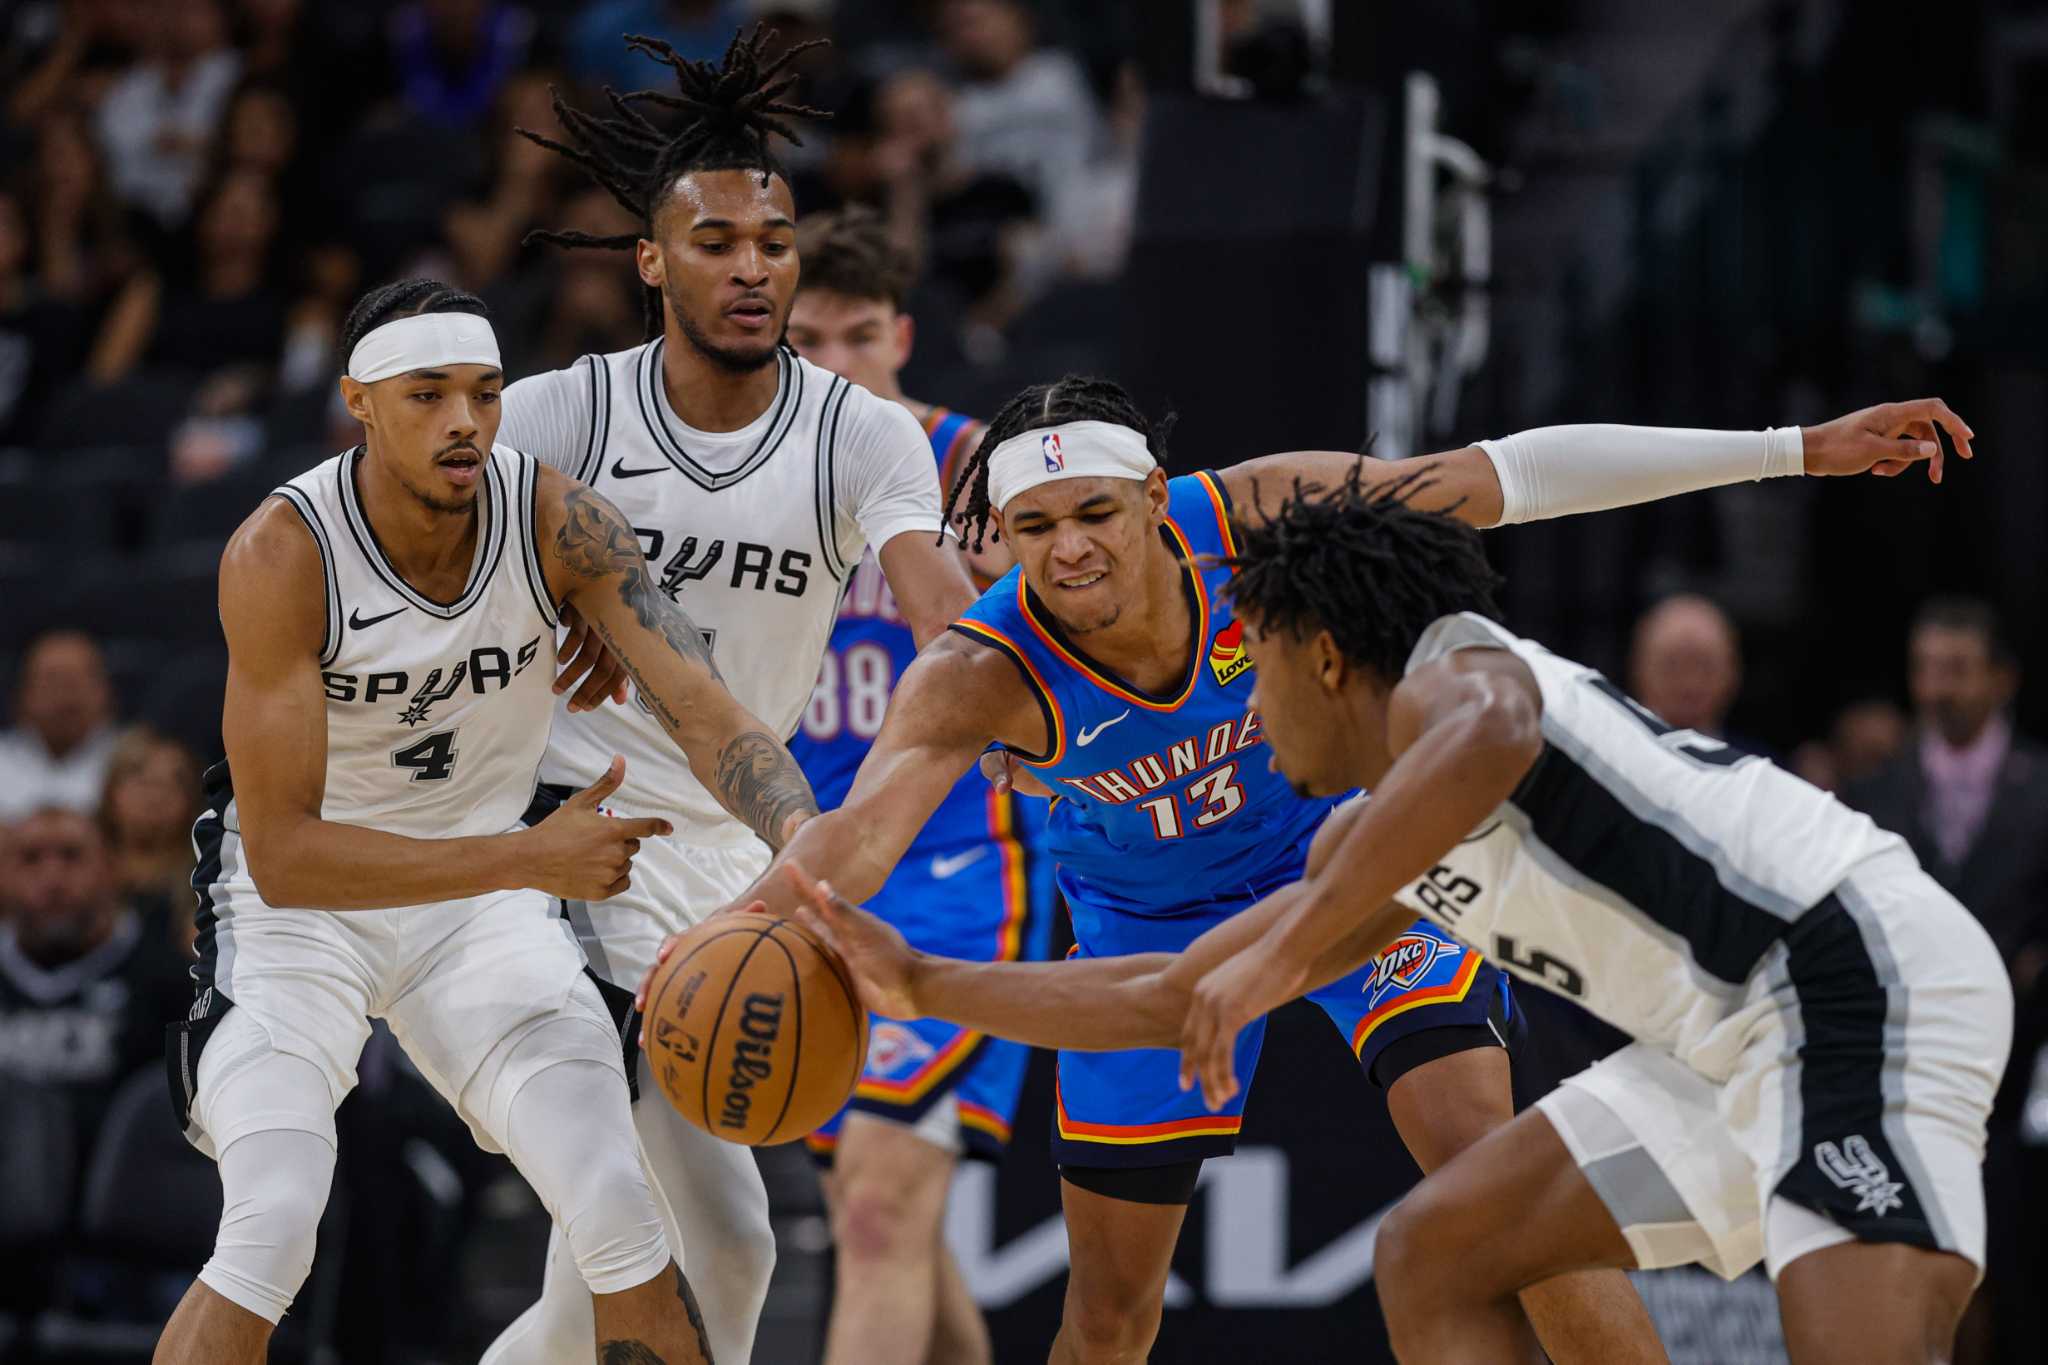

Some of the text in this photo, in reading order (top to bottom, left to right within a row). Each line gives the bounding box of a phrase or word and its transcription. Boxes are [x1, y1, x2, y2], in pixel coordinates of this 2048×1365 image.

[321, 635, 541, 728] SPURS
[802, 644, 892, 740] 88
[390, 728, 459, 783] 4
[1058, 710, 1262, 804] THUNDE
[1136, 761, 1246, 840] 13
[1374, 940, 1424, 993] OKC
[1496, 933, 1587, 998] 5
[719, 992, 785, 1130] Wilson
